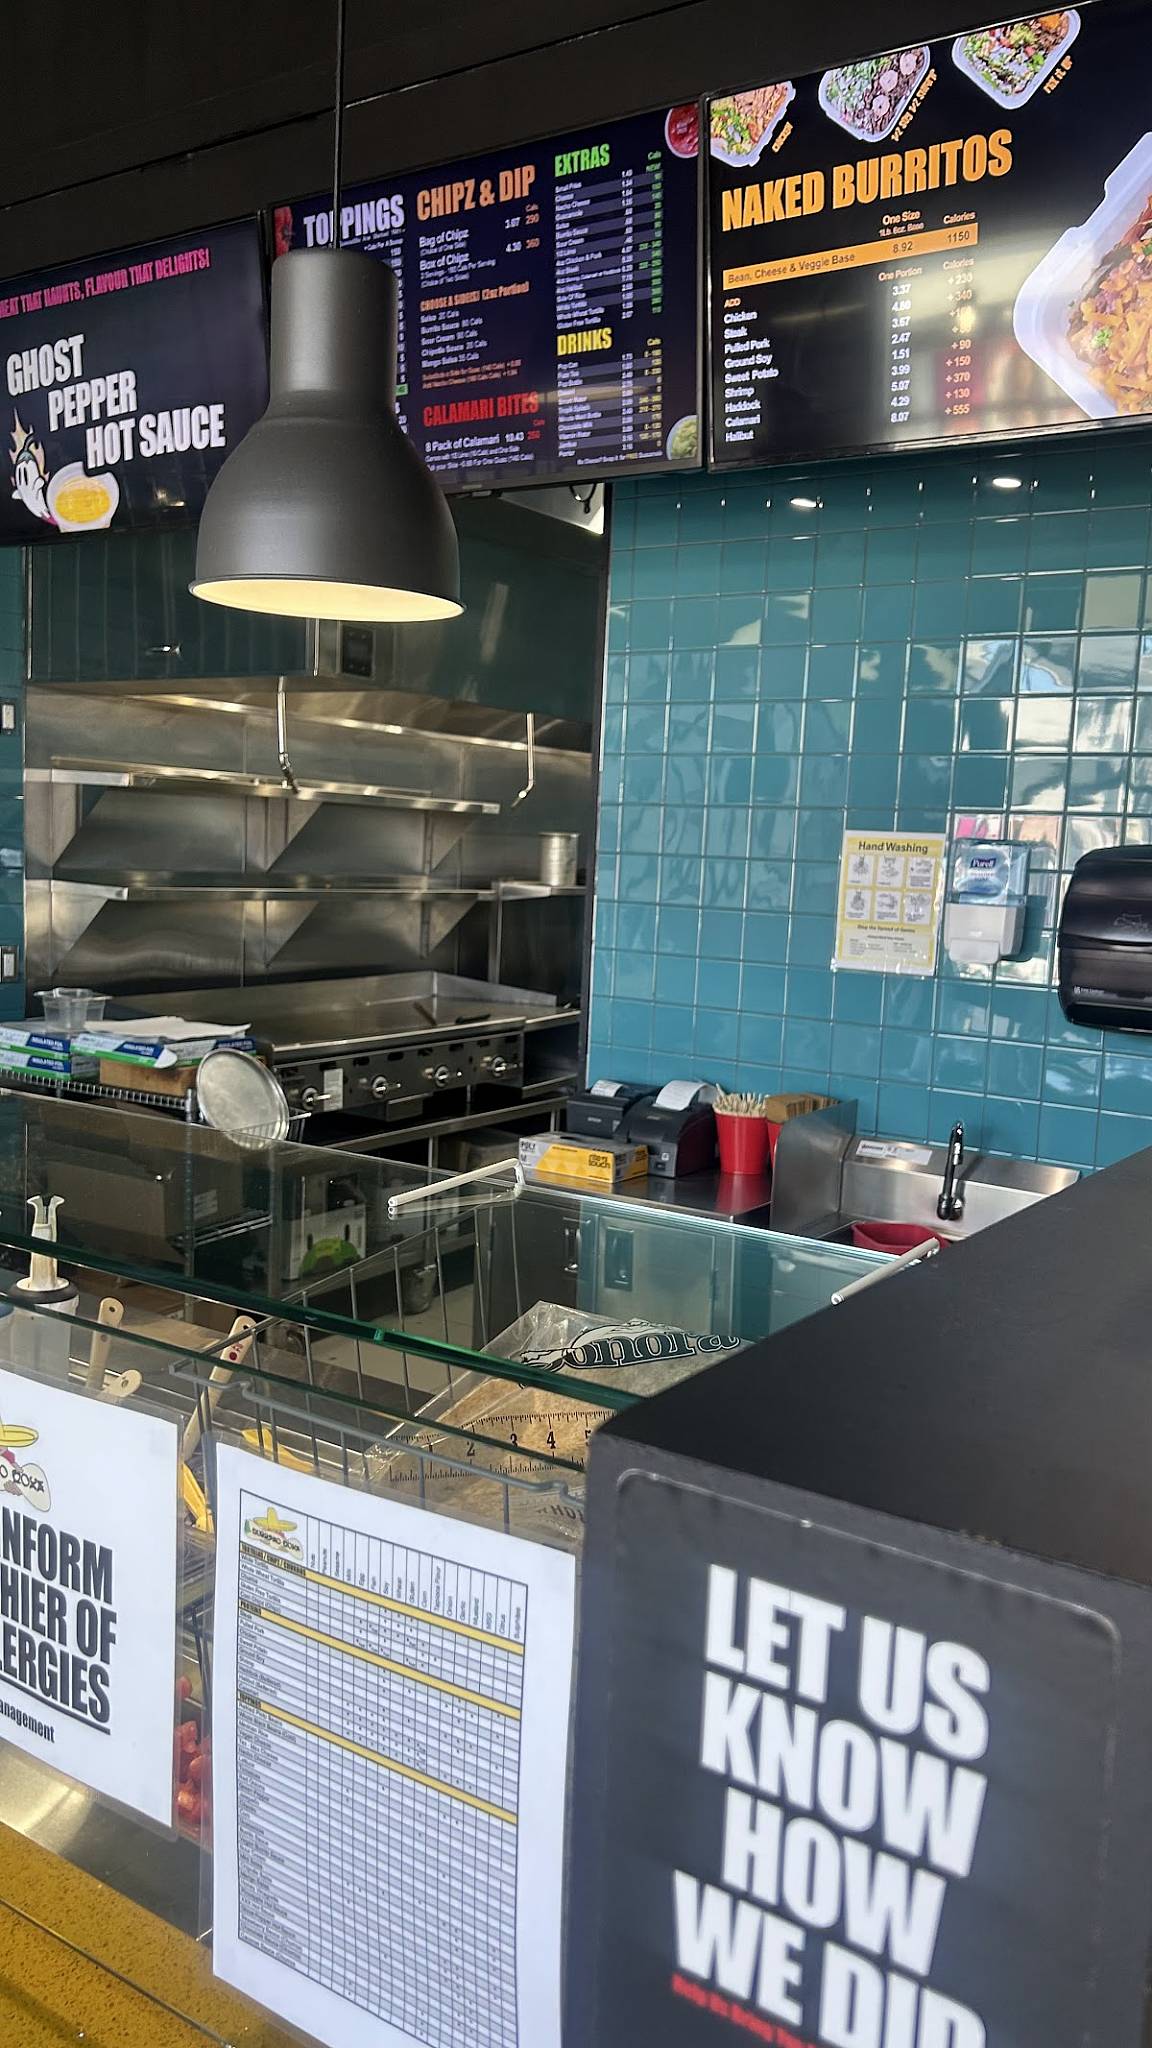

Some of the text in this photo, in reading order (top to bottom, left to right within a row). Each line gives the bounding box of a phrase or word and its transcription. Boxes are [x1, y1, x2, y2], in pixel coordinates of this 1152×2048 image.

[555, 143, 610, 178] EXTRAS
[416, 164, 536, 221] CHIPZ & DIP
[721, 128, 1013, 232] NAKED BURRITOS
[882, 210, 976, 226] One Size Calories
[419, 236, 436, 248] Bag
[436, 232, 446, 244] of
[947, 230, 970, 244] 1150
[84, 269, 129, 298] FLAVOUR
[128, 262, 154, 286] THAT
[155, 248, 211, 280] DELIGHTS!
[420, 259, 436, 272] Box
[436, 255, 446, 268] of
[728, 252, 856, 285] Bean, Cheese & Veggie Base
[878, 258, 974, 282] One Portion Calories
[724, 311, 758, 324] Chicken
[556, 326, 612, 356] DRINKS
[750, 338, 771, 350] Pork
[6, 333, 85, 396] GHOST
[756, 353, 774, 366] Soy
[48, 370, 138, 432] PEPPER
[423, 391, 539, 428] CALAMARI BITES
[86, 404, 226, 470] HOT SAUCE
[452, 438, 462, 449] of
[858, 841, 929, 855] Hand Washing
[546, 1431, 556, 1449] 4
[76, 1598, 117, 1666] OF
[0, 1620, 111, 1724] ERGIES
[705, 1562, 990, 1761] LET US
[700, 1669, 988, 1879] KNOW
[721, 1785, 946, 1978] HOW
[673, 1868, 988, 2048] WE DID
